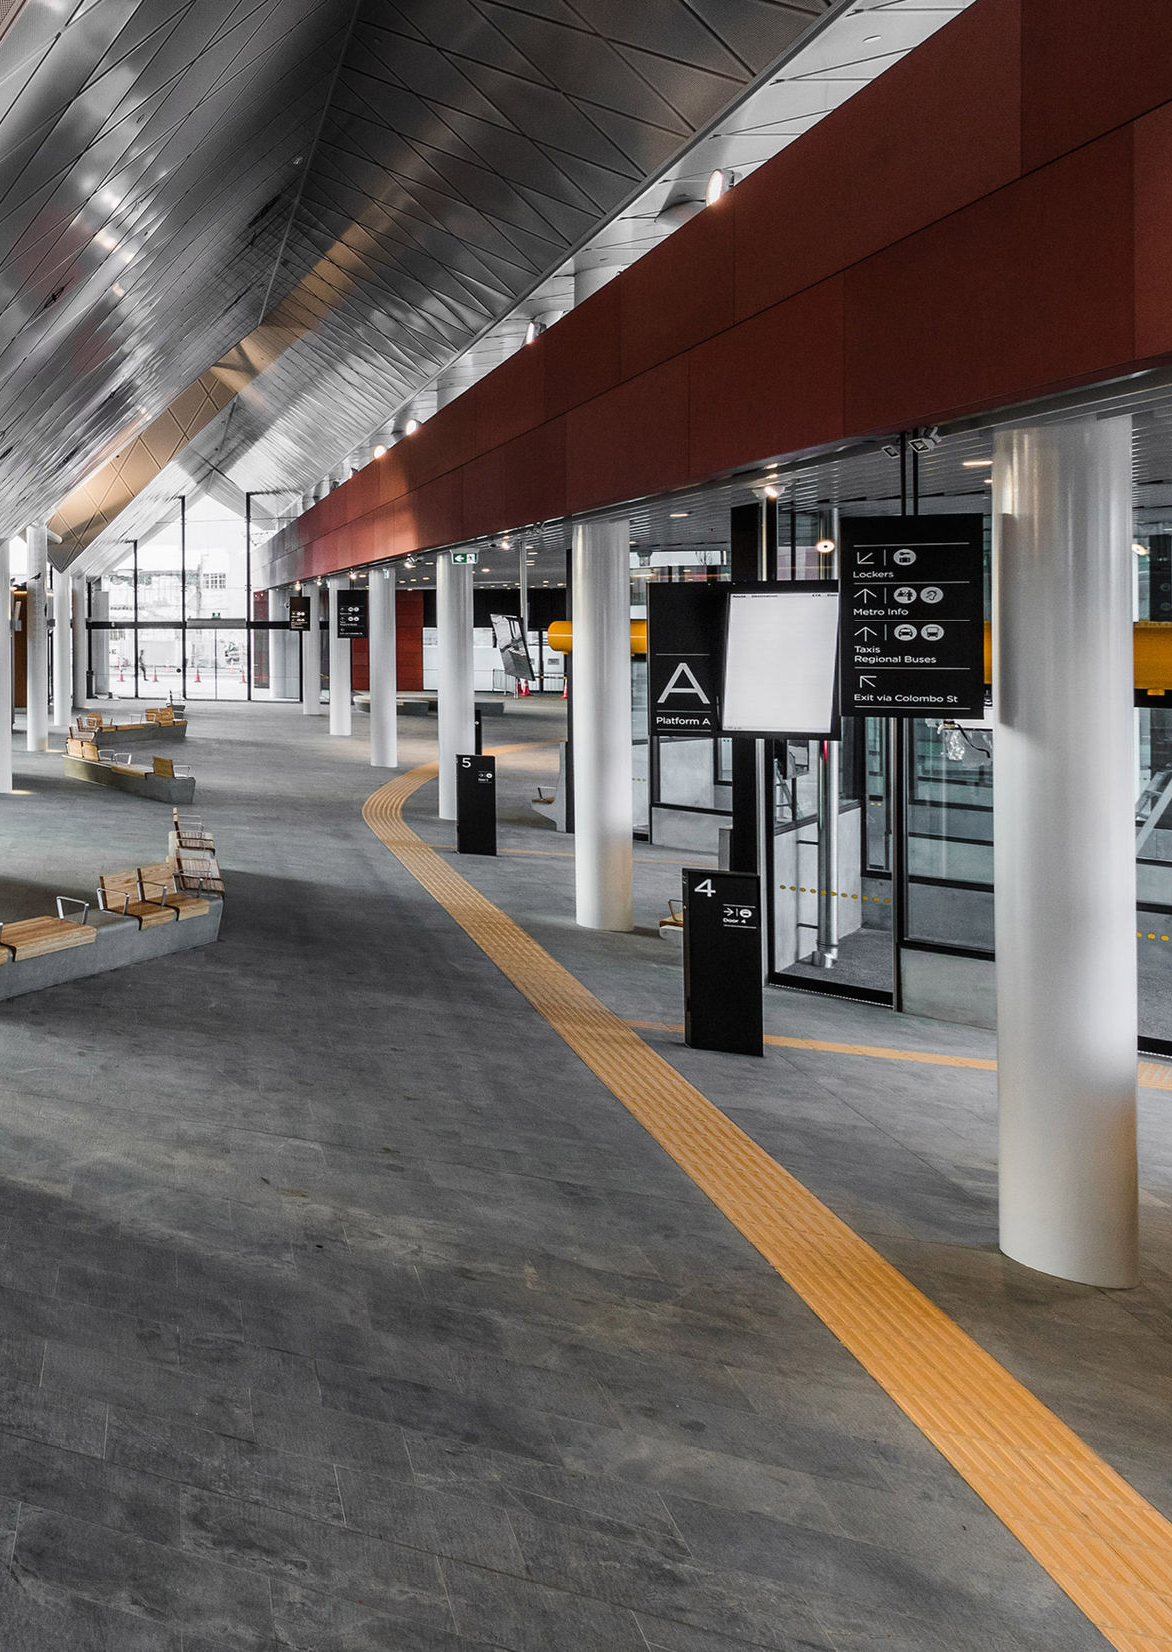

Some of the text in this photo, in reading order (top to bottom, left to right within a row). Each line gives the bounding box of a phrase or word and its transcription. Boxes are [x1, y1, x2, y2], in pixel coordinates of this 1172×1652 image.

[853, 608, 885, 616] Metro
[854, 645, 881, 653] Taxis
[854, 655, 902, 664] Regional
[657, 662, 711, 704] A
[894, 694, 944, 702] Colombo
[946, 695, 958, 703] St
[656, 716, 700, 725] Platform
[462, 757, 471, 768] 5
[694, 879, 716, 897] 4
